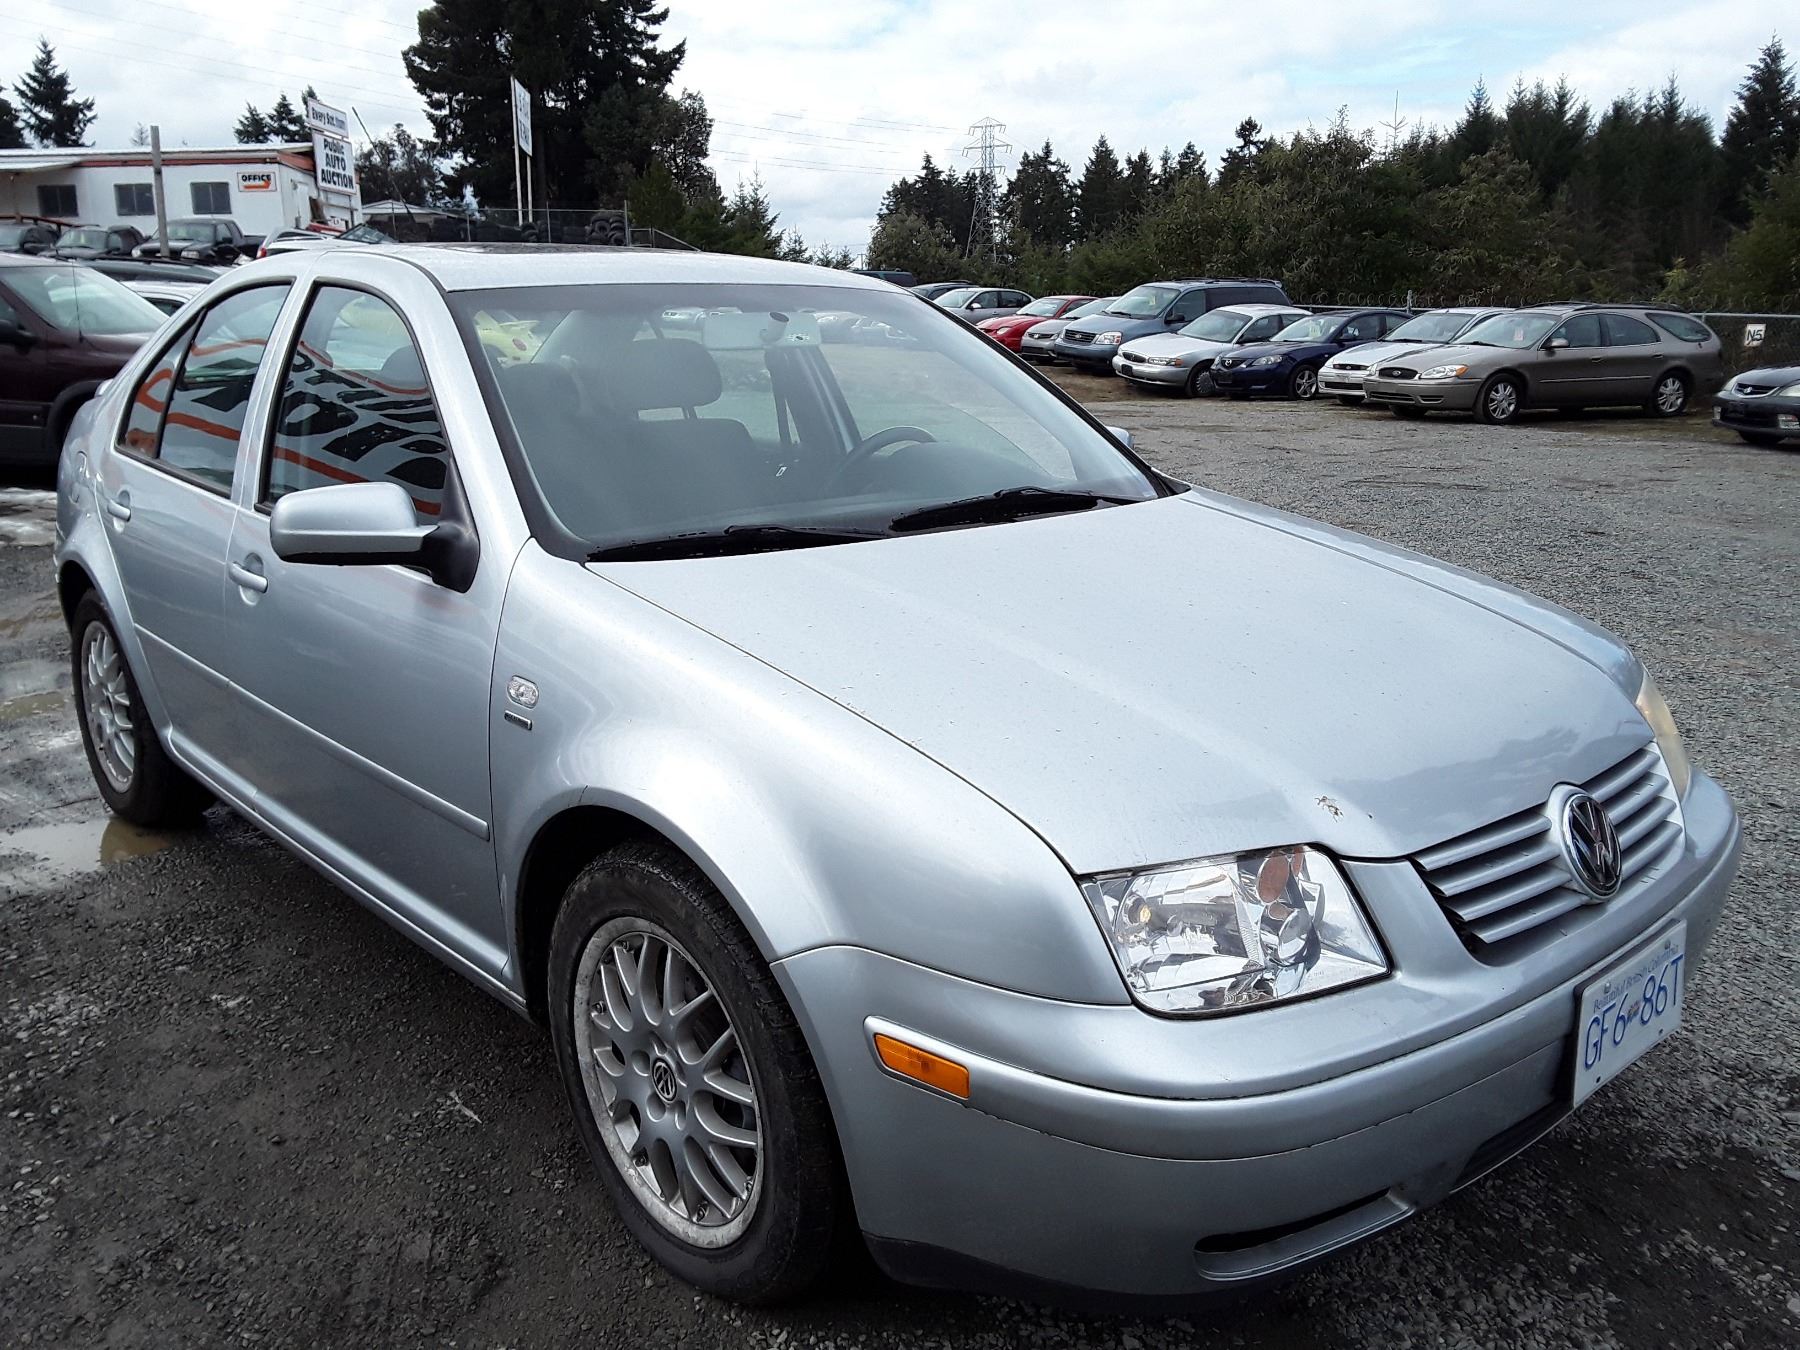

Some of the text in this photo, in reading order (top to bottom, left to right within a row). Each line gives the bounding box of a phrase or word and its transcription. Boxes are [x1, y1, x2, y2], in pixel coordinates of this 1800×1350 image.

[325, 152, 347, 172] AUTO
[241, 174, 272, 182] OFFICE
[321, 168, 354, 190] AUCTION
[1746, 329, 1763, 341] N5
[1584, 993, 1628, 1071] GF6
[1640, 954, 1684, 1026] 86T
